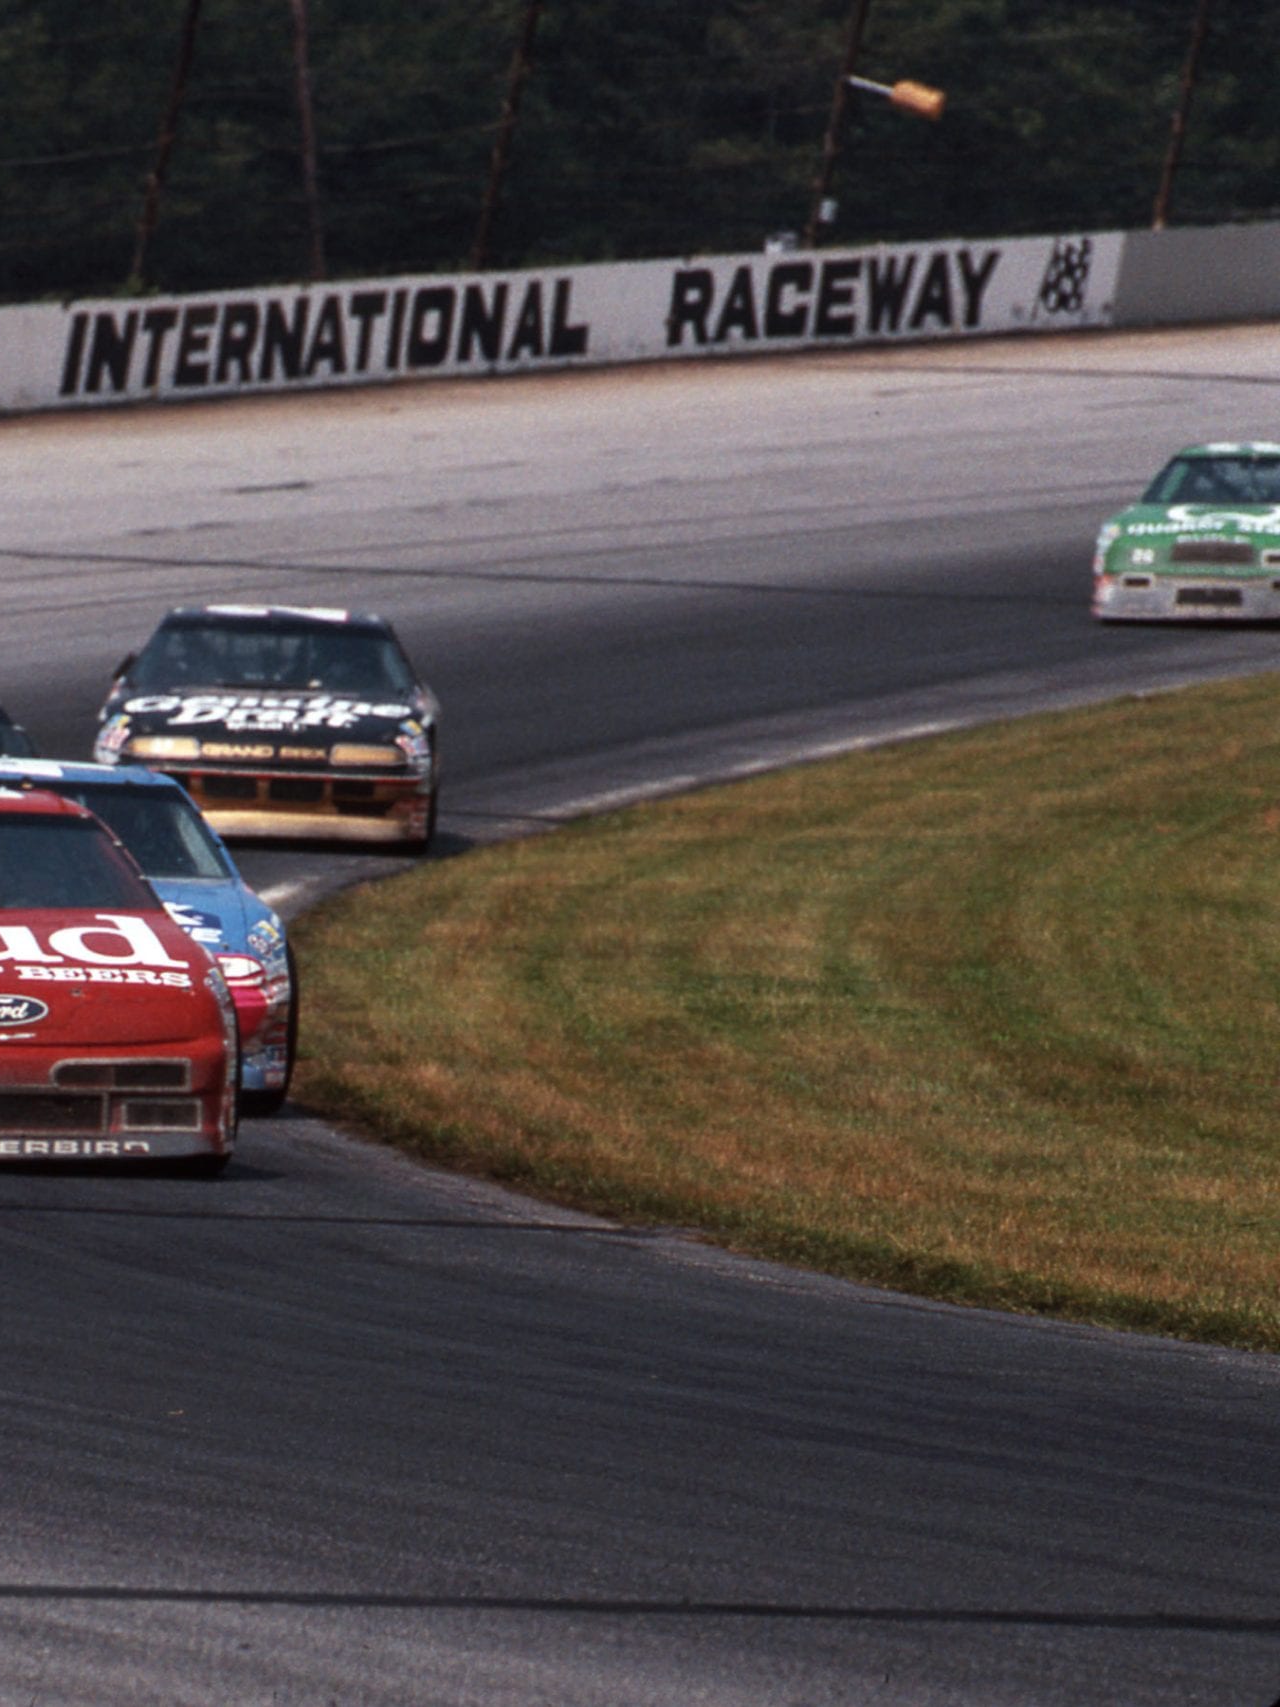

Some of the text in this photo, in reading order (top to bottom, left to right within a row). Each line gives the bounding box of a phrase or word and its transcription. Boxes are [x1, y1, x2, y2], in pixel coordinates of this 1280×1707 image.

[60, 278, 589, 395] INTERNATIONAL
[666, 249, 1000, 348] RACEWAY
[14, 965, 193, 988] BEERS
